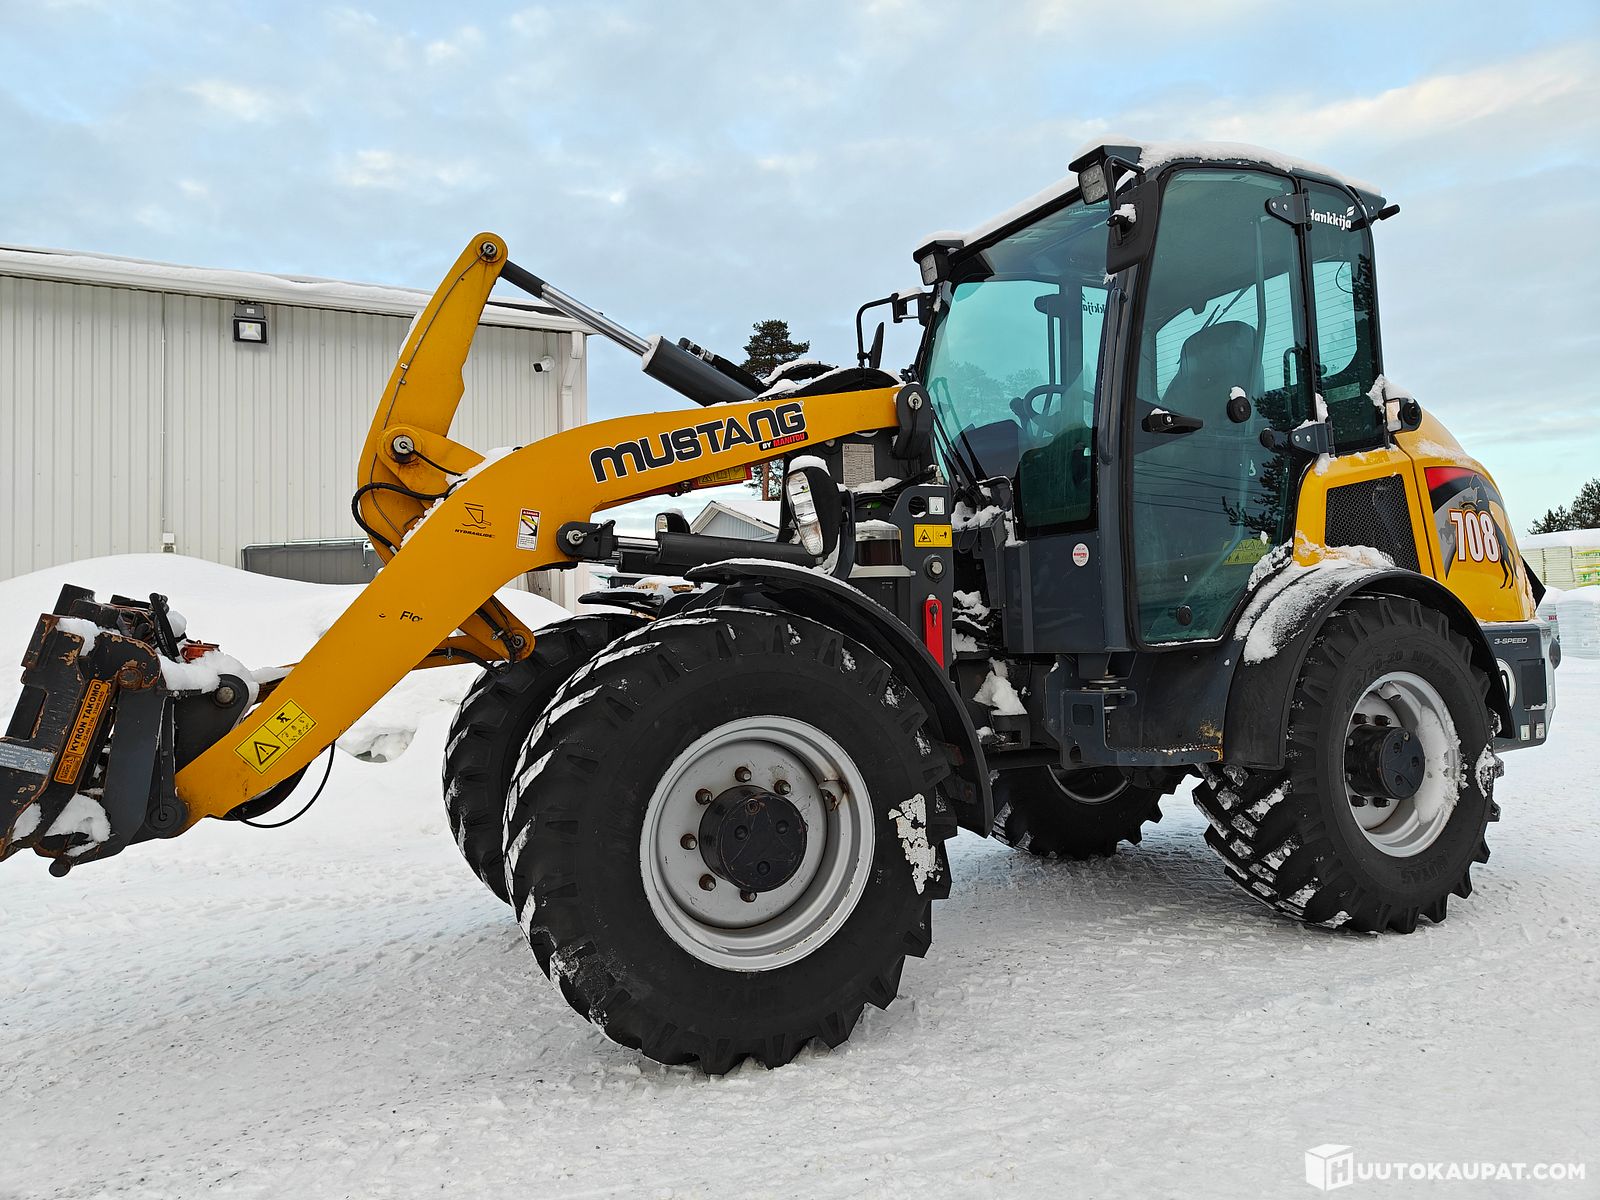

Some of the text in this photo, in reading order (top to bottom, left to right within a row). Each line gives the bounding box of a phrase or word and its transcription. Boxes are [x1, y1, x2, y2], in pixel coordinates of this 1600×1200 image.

[590, 402, 805, 483] MUSTANG
[762, 433, 805, 449] BY MANITOU
[1449, 509, 1500, 562] 708
[1494, 637, 1527, 645] 3-SPEED
[83, 683, 101, 720] TAKOMO
